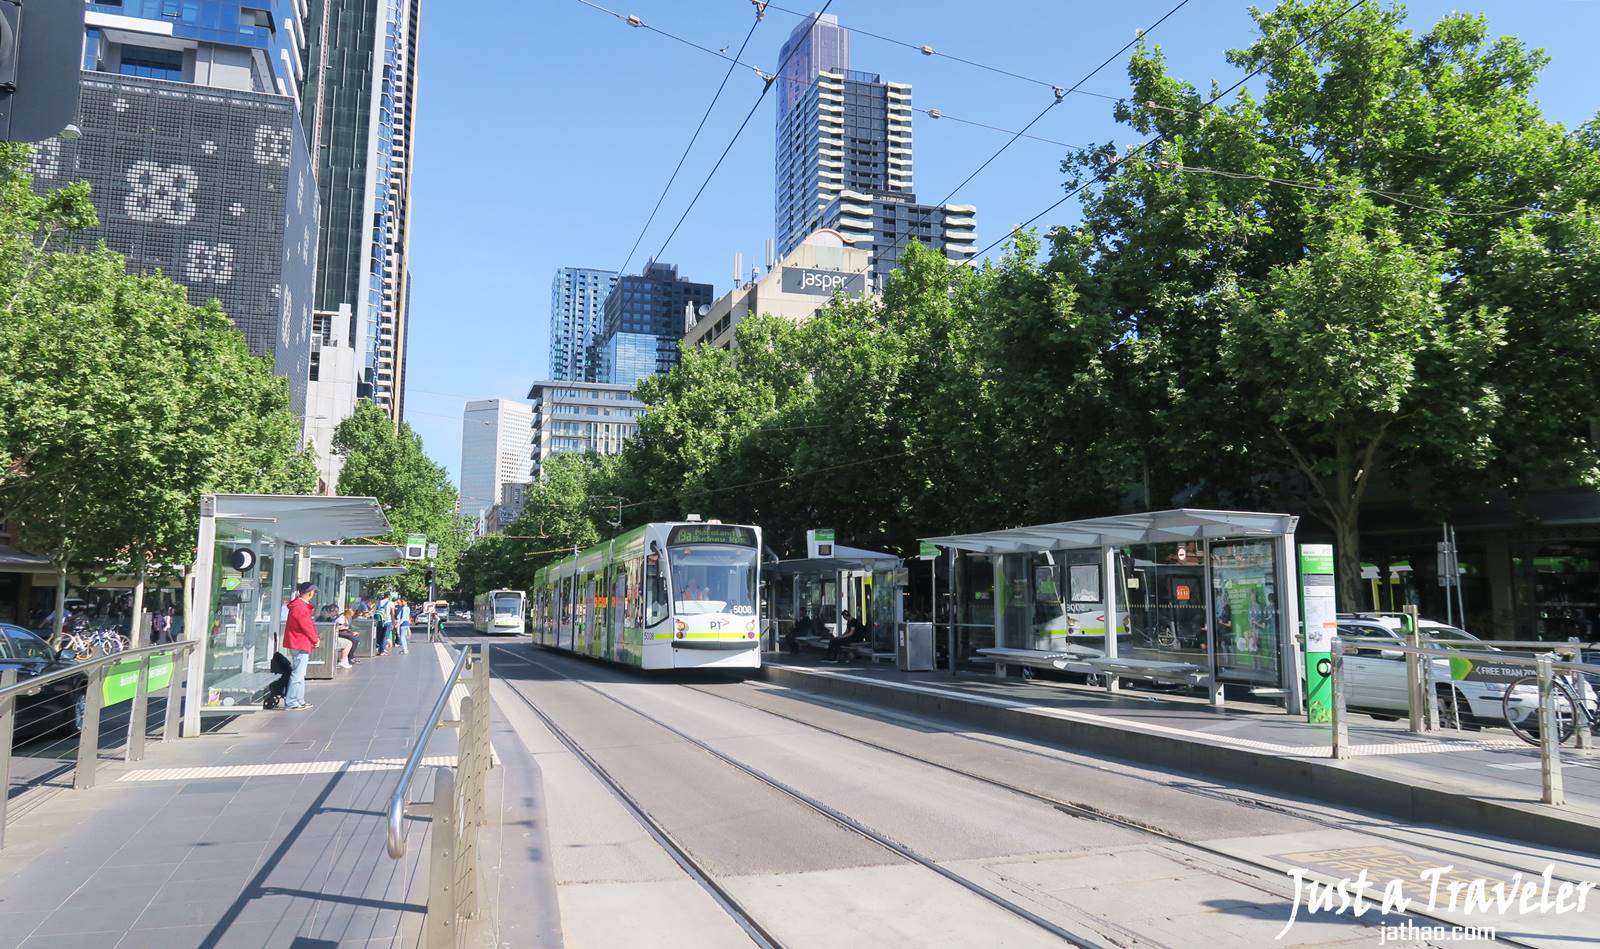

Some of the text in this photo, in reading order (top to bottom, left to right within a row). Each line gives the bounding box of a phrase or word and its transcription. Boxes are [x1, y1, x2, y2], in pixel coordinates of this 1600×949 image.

[733, 605, 753, 614] 5008
[1481, 666, 1500, 675] FREE
[1501, 668, 1523, 677] TRAM
